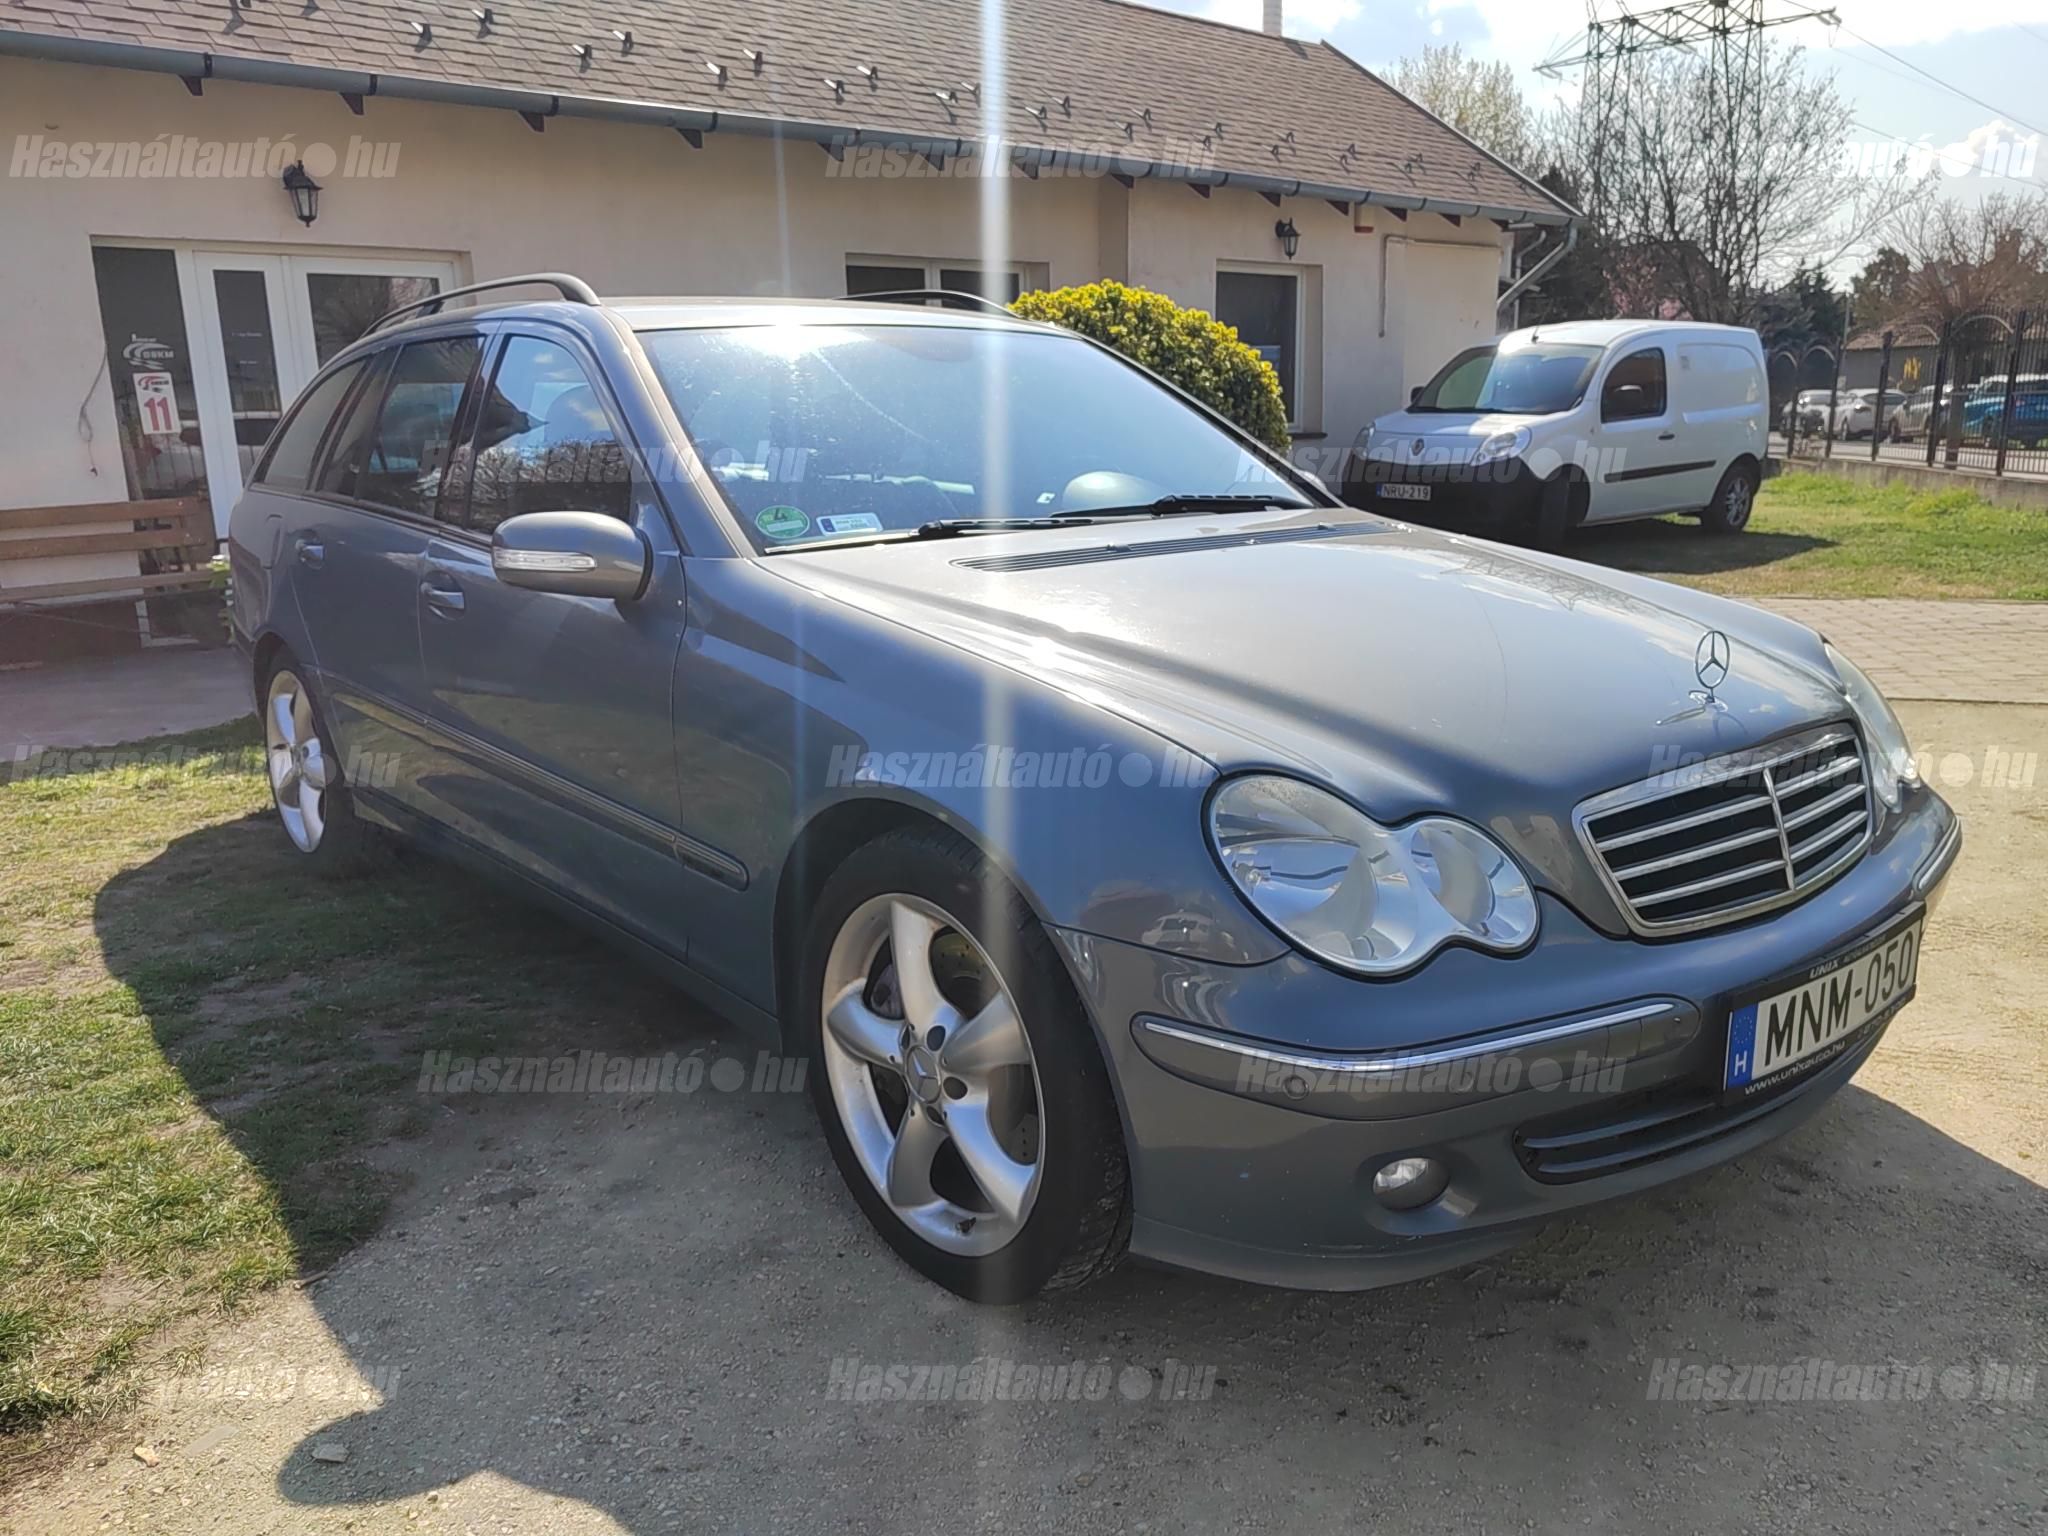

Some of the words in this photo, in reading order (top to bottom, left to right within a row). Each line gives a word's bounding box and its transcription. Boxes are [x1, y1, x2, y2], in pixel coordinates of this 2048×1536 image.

[143, 396, 172, 432] 11
[1382, 485, 1429, 499] NRU-219
[1809, 959, 1839, 979] UNIX
[1764, 930, 1914, 1067] MNM-050
[1733, 1050, 1748, 1077] H
